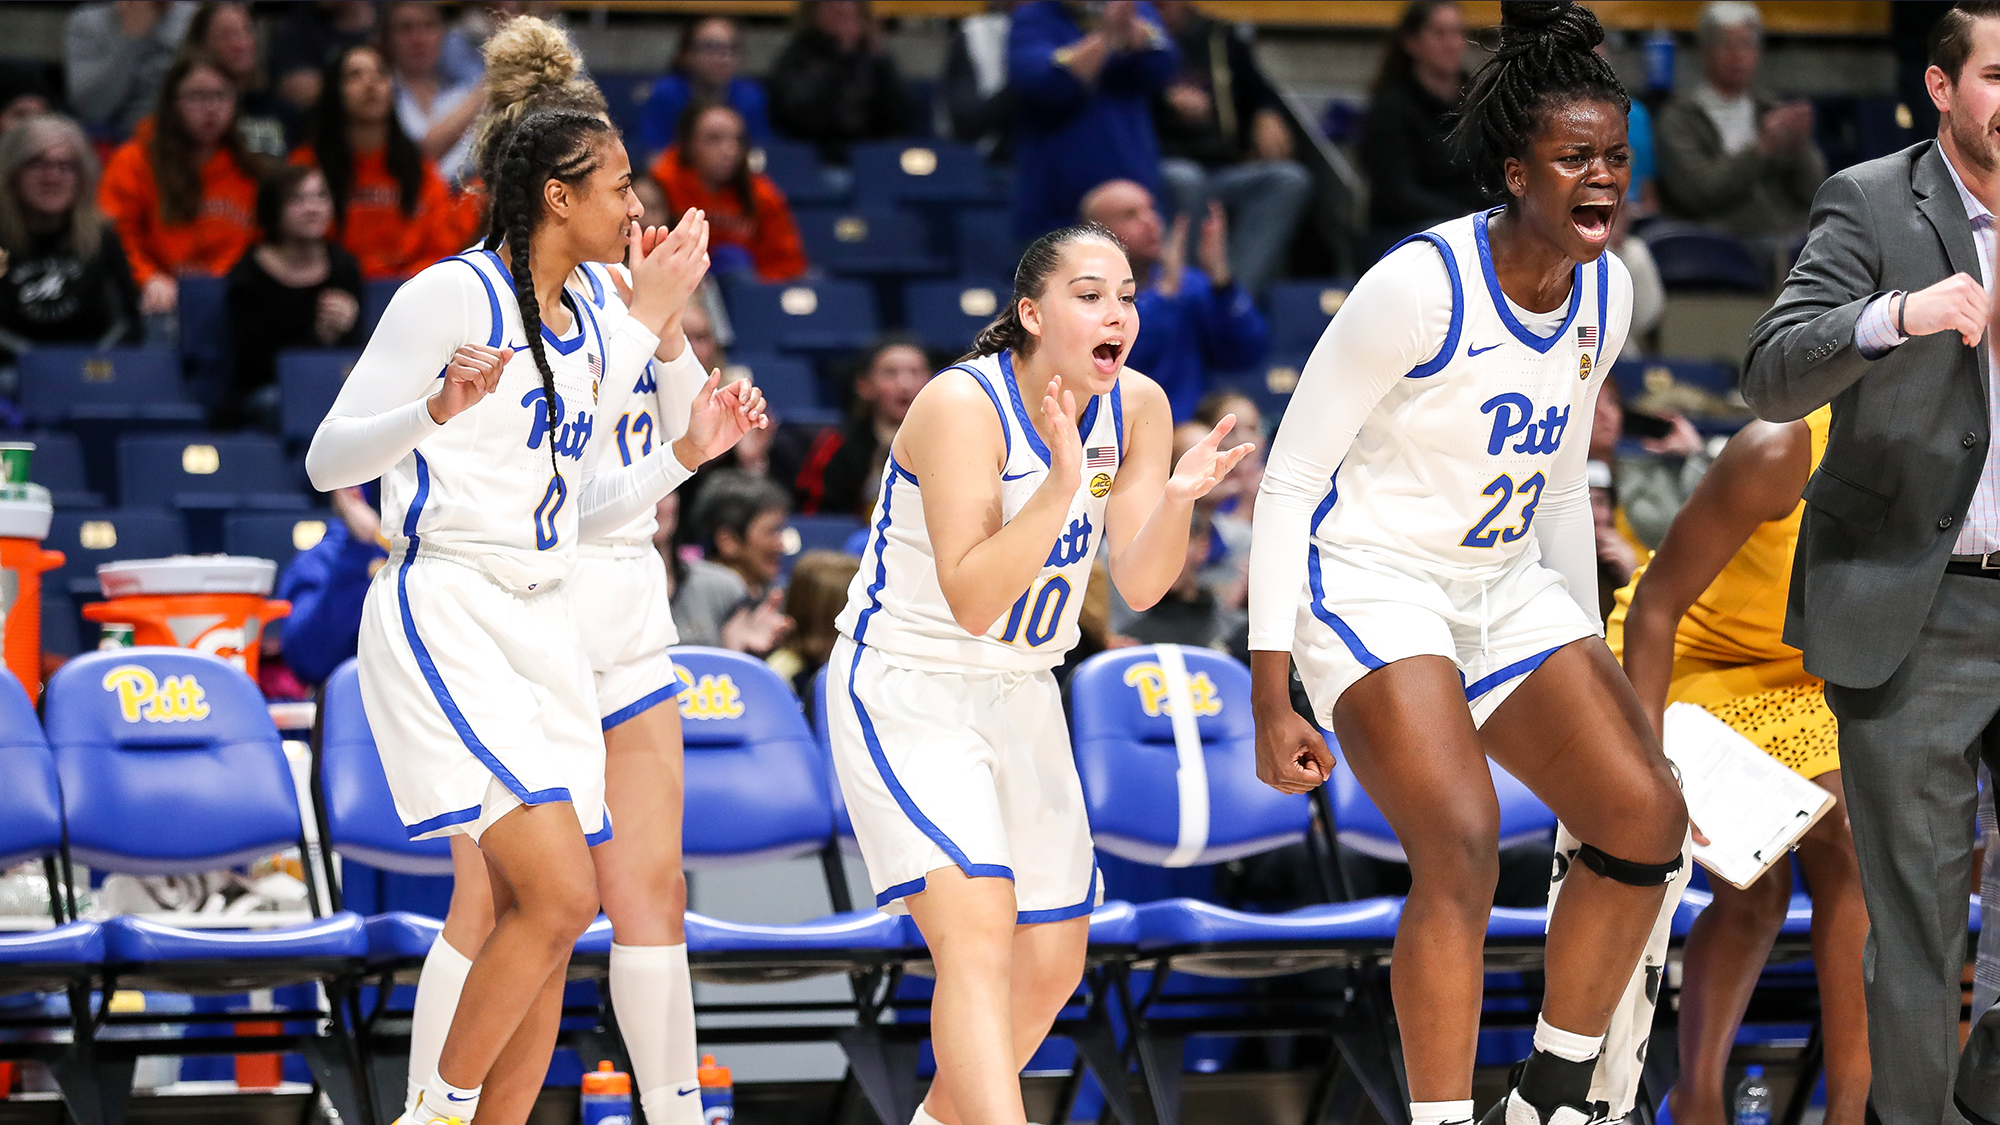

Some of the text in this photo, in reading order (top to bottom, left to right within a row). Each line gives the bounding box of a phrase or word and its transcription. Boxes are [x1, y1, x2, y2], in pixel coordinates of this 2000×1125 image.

[521, 387, 593, 461] Pitt
[1480, 392, 1570, 455] Pitt
[534, 472, 567, 551] 0
[1092, 480, 1111, 488] ACC
[1458, 469, 1547, 548] 23
[1044, 512, 1092, 567] itt
[999, 573, 1072, 648] 10
[102, 664, 211, 723] Pitt
[1123, 661, 1223, 717] Pt
